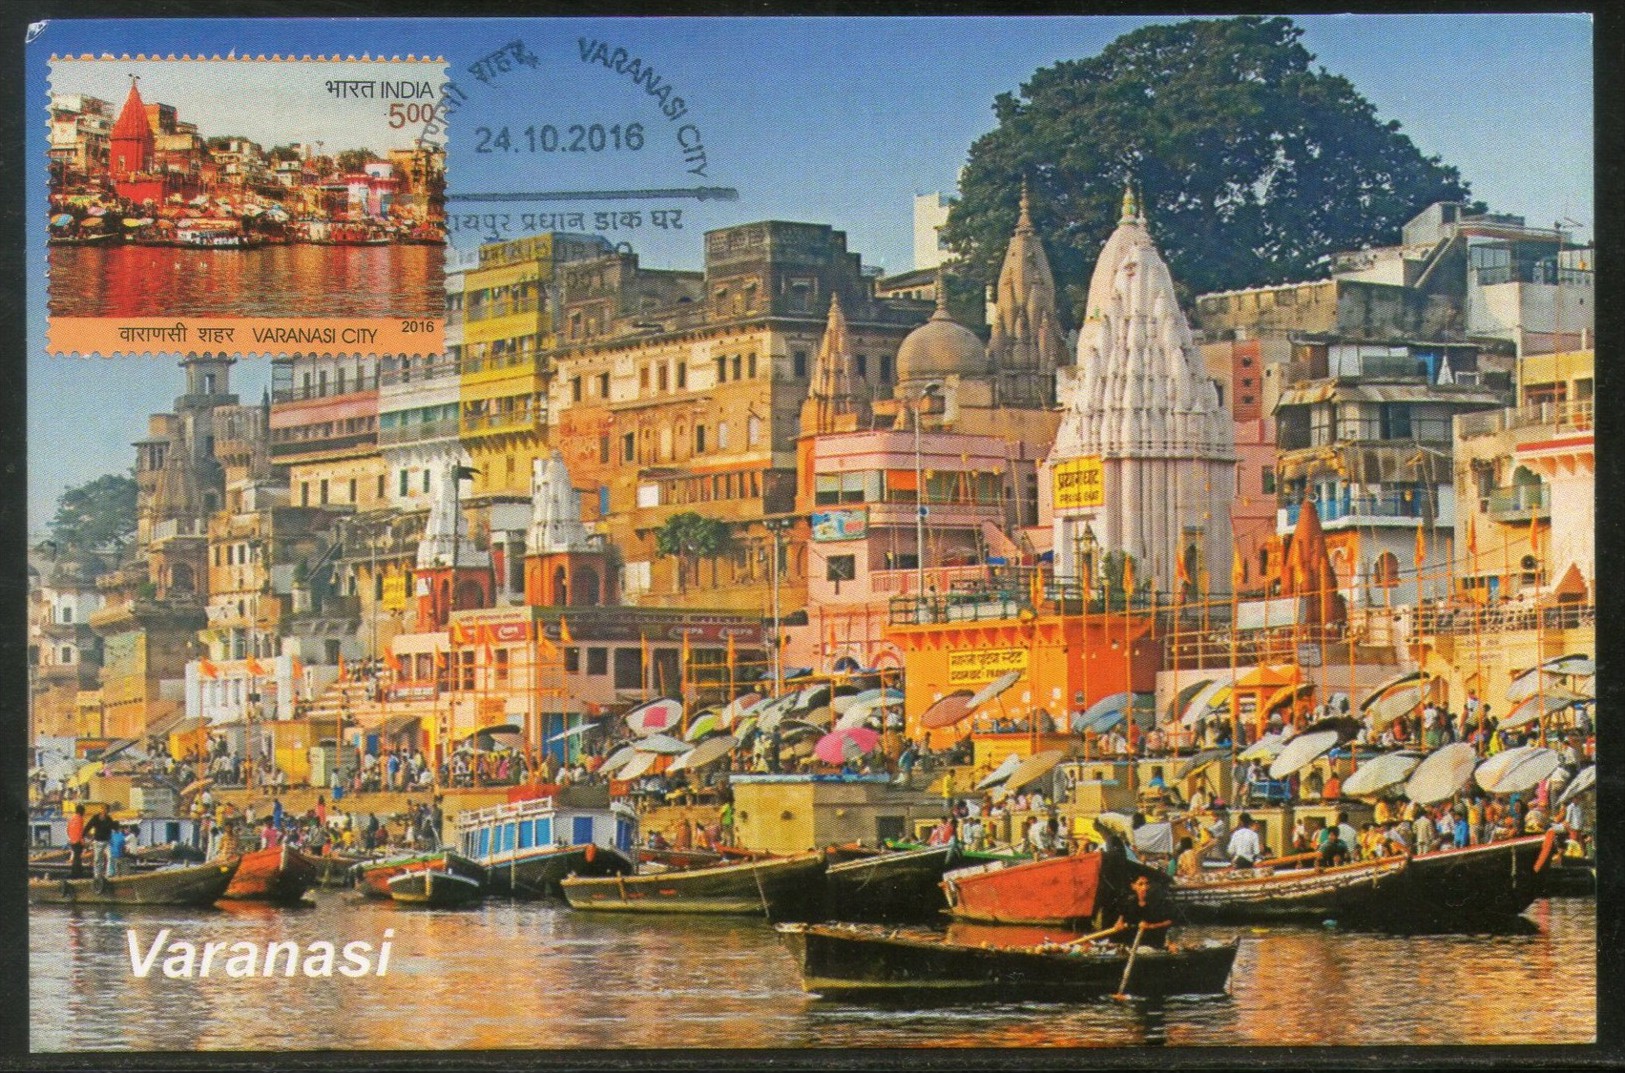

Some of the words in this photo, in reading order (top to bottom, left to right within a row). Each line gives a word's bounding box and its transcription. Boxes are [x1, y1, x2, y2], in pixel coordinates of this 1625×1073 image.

[325, 80, 376, 98] भारत
[380, 81, 434, 98] INDIA
[577, 36, 689, 122] VARANASI
[676, 123, 709, 179] CITY
[474, 122, 645, 153] 24.10.2016
[520, 211, 587, 232] प्रधान
[593, 210, 643, 231] डाक
[650, 208, 684, 231] घर
[118, 321, 187, 343] वाराणसी
[197, 327, 235, 343] शहर
[252, 327, 336, 344] VARANASI
[341, 327, 379, 344] CITY
[401, 320, 435, 333] 2016
[126, 927, 396, 979] Varanasi
